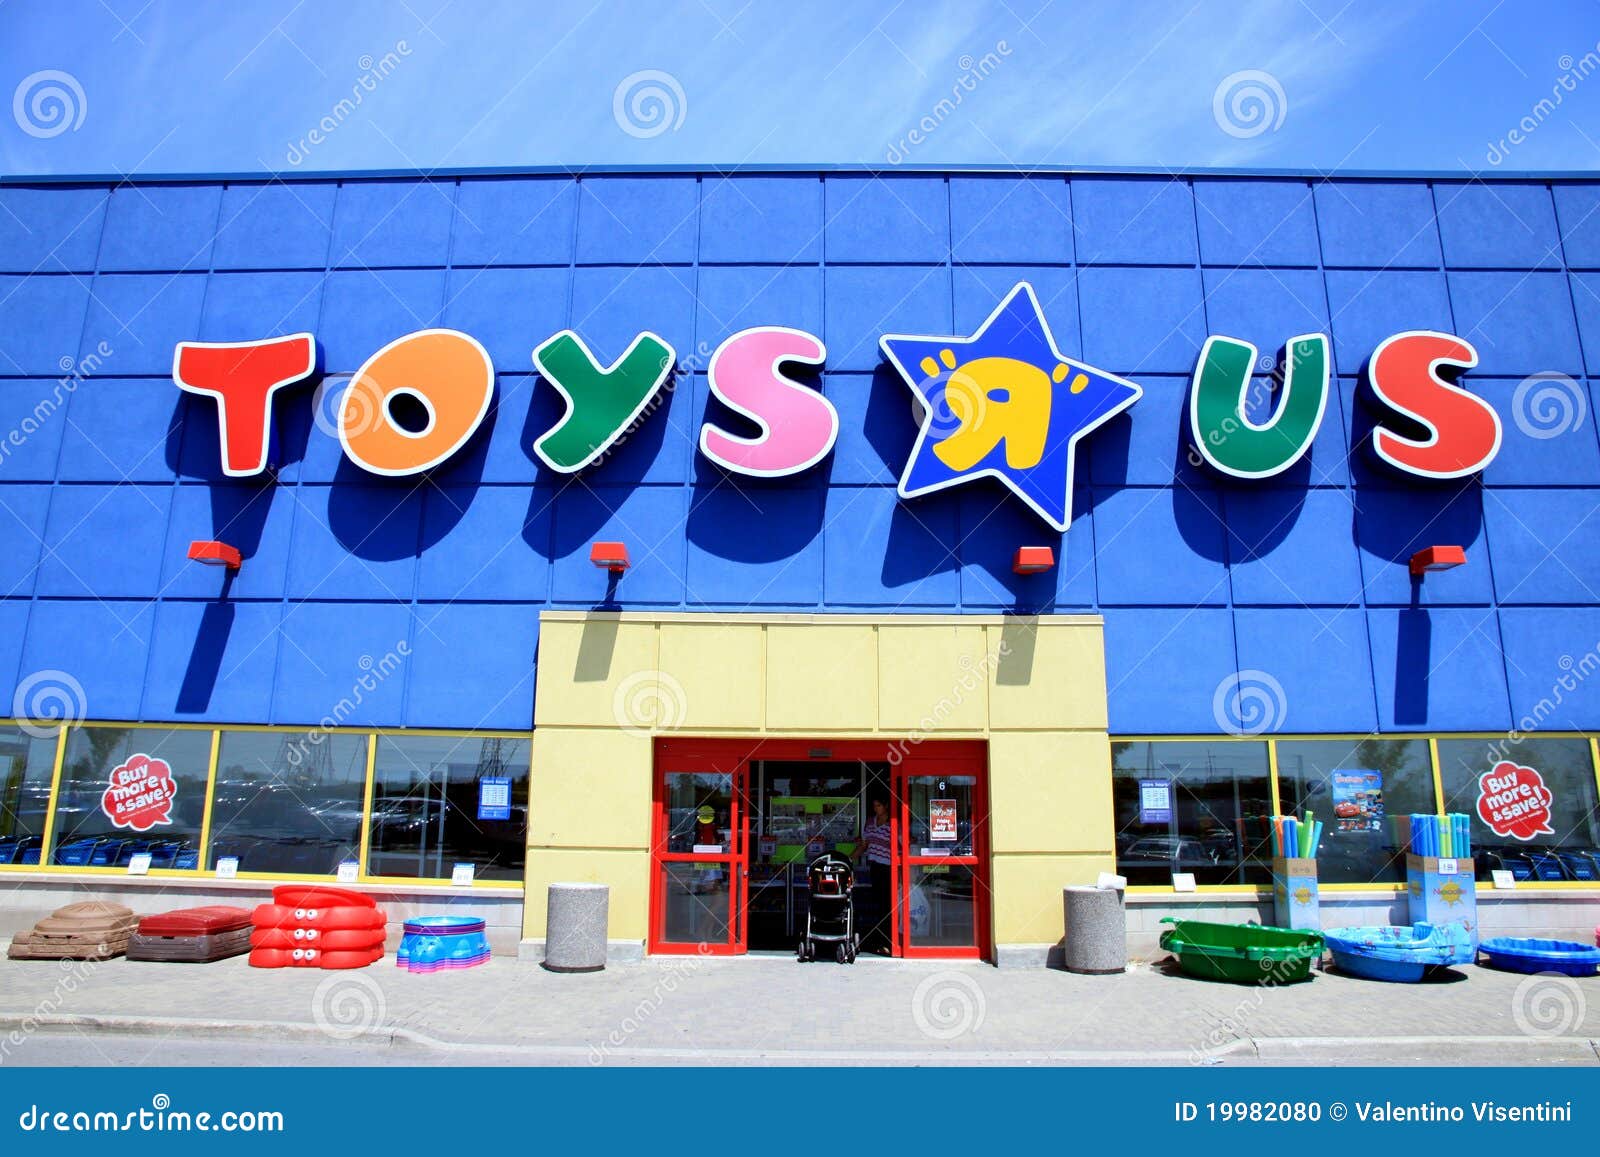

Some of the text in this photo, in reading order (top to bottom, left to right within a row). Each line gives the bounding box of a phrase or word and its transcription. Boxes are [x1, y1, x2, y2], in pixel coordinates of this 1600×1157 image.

[172, 326, 839, 478] TOYS
[1190, 329, 1503, 481] US
[118, 764, 148, 786] Buy
[939, 781, 946, 790] 6
[1487, 772, 1517, 794] Buy
[112, 775, 158, 802] more
[1486, 783, 1532, 810] more
